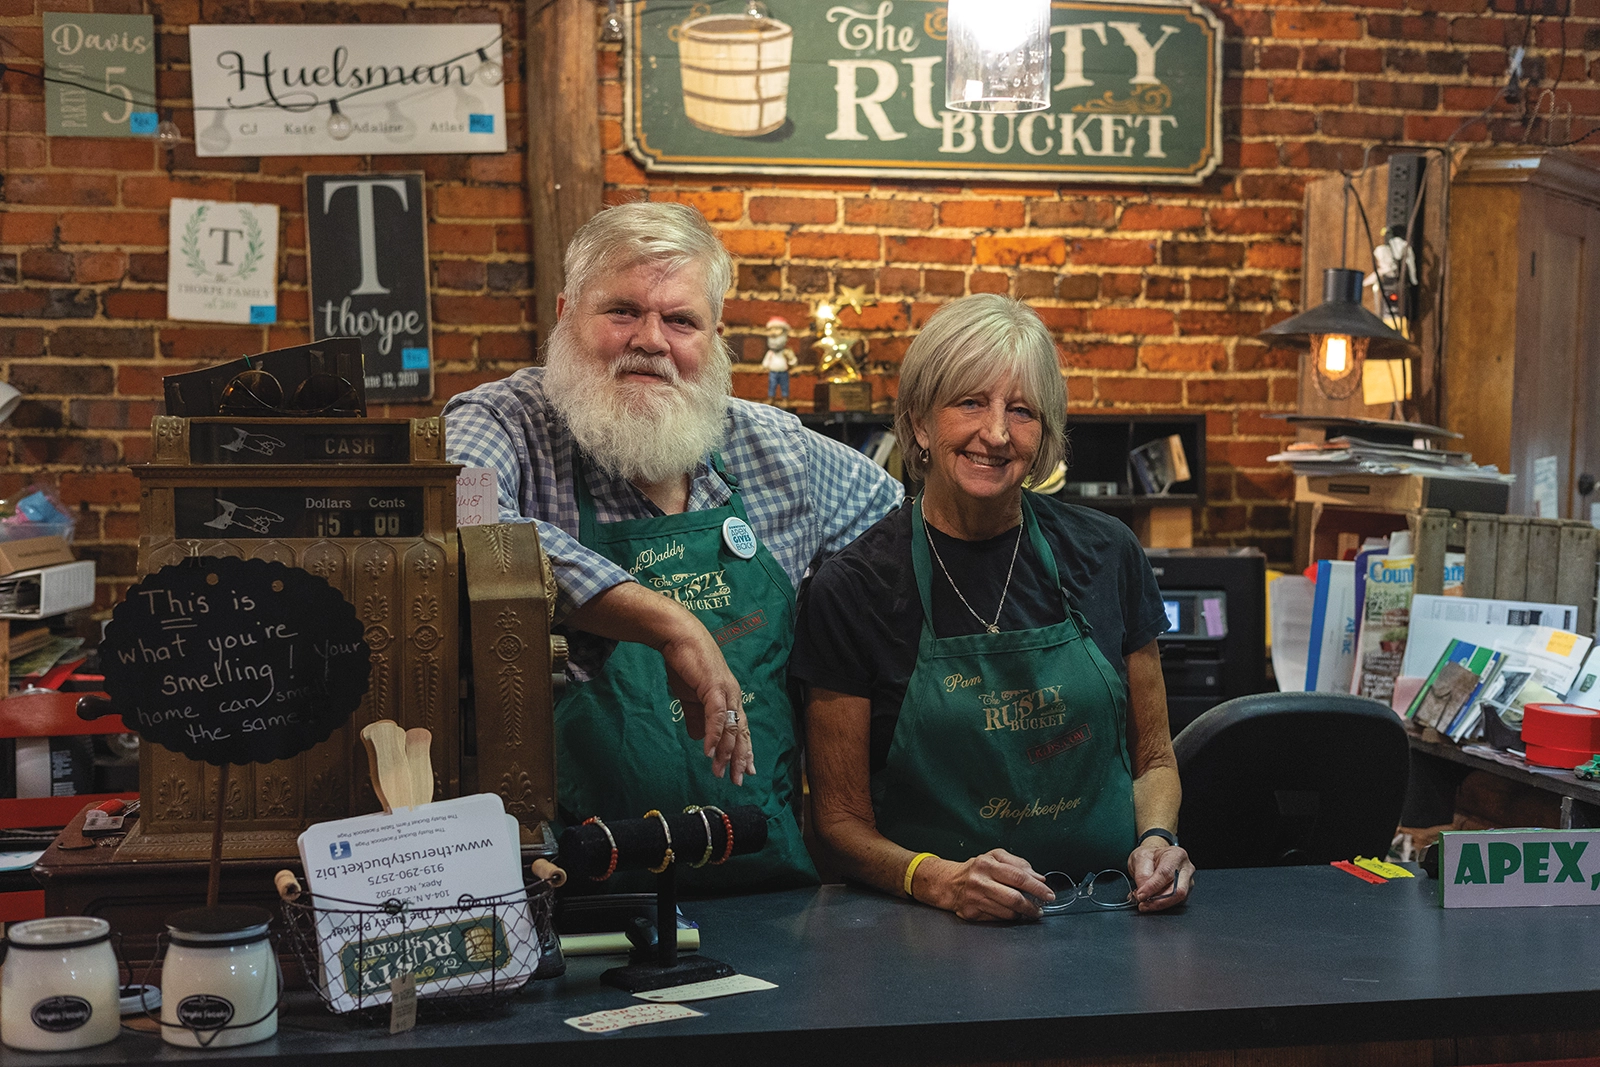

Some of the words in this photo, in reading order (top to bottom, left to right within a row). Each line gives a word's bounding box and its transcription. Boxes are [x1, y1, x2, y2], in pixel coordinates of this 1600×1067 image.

[51, 23, 153, 55] Davis
[826, 1, 919, 53] The
[217, 45, 474, 112] Huelsman
[825, 21, 1180, 142] RUTY
[102, 67, 134, 124] 5
[239, 123, 258, 135] CJ
[939, 111, 1179, 159] BUCKET
[209, 227, 243, 265] T
[323, 179, 410, 295] T
[317, 296, 424, 355] thorpe
[364, 375, 381, 389] une
[325, 438, 375, 454] CASH
[305, 497, 352, 509] Dollars
[368, 497, 405, 508] Cents
[733, 535, 751, 543] GIVES
[639, 540, 685, 569] Daddy
[649, 574, 673, 588] The
[139, 590, 209, 615] This
[232, 590, 256, 611] is
[684, 595, 731, 611] BUCKET
[117, 633, 187, 664] what
[208, 621, 298, 671] you're
[944, 673, 982, 692] Pam
[978, 691, 1000, 706] The
[983, 685, 1063, 731] RUSTY
[137, 706, 200, 727] home
[219, 698, 258, 714] can
[1011, 713, 1066, 731] BUCKET
[185, 724, 231, 744] the
[980, 797, 1081, 825] Shopkeeper
[315, 838, 493, 880] www.therustybucket.biz
[367, 863, 445, 886] 919-290-2575
[418, 880, 442, 889] Apex,
[376, 887, 402, 899] 27502
[404, 885, 417, 894] NC
